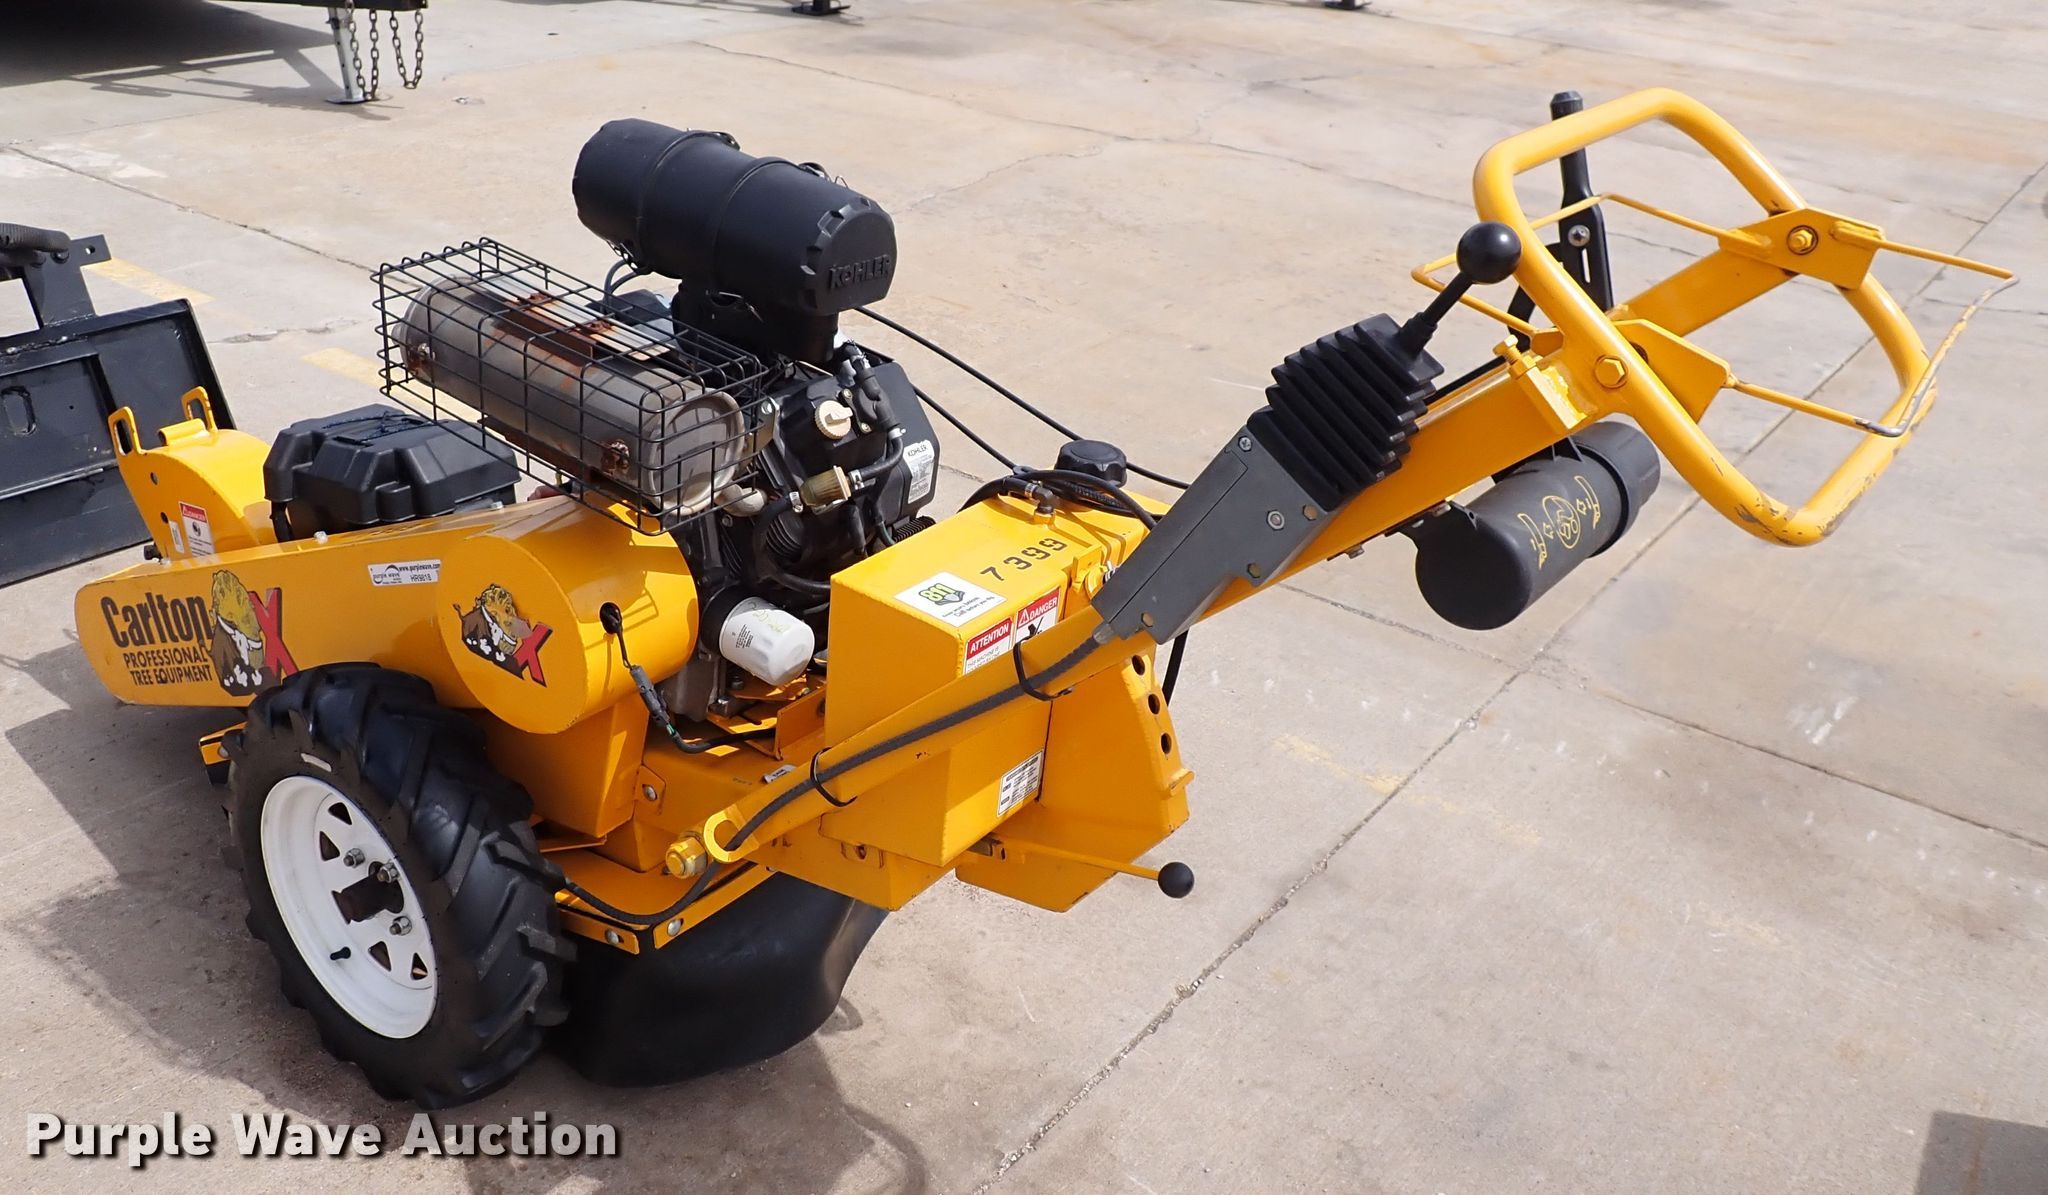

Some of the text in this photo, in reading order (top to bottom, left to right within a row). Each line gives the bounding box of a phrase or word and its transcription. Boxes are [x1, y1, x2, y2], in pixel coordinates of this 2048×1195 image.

[828, 254, 890, 289] KOHLER
[980, 537, 1068, 581] 7399
[100, 592, 214, 648] Carlton
[1029, 597, 1058, 620] DANGER
[970, 623, 1010, 655] ATTENTION
[123, 646, 209, 669] PROFESSIONAL
[130, 664, 214, 686] TREE EQUIPMENT
